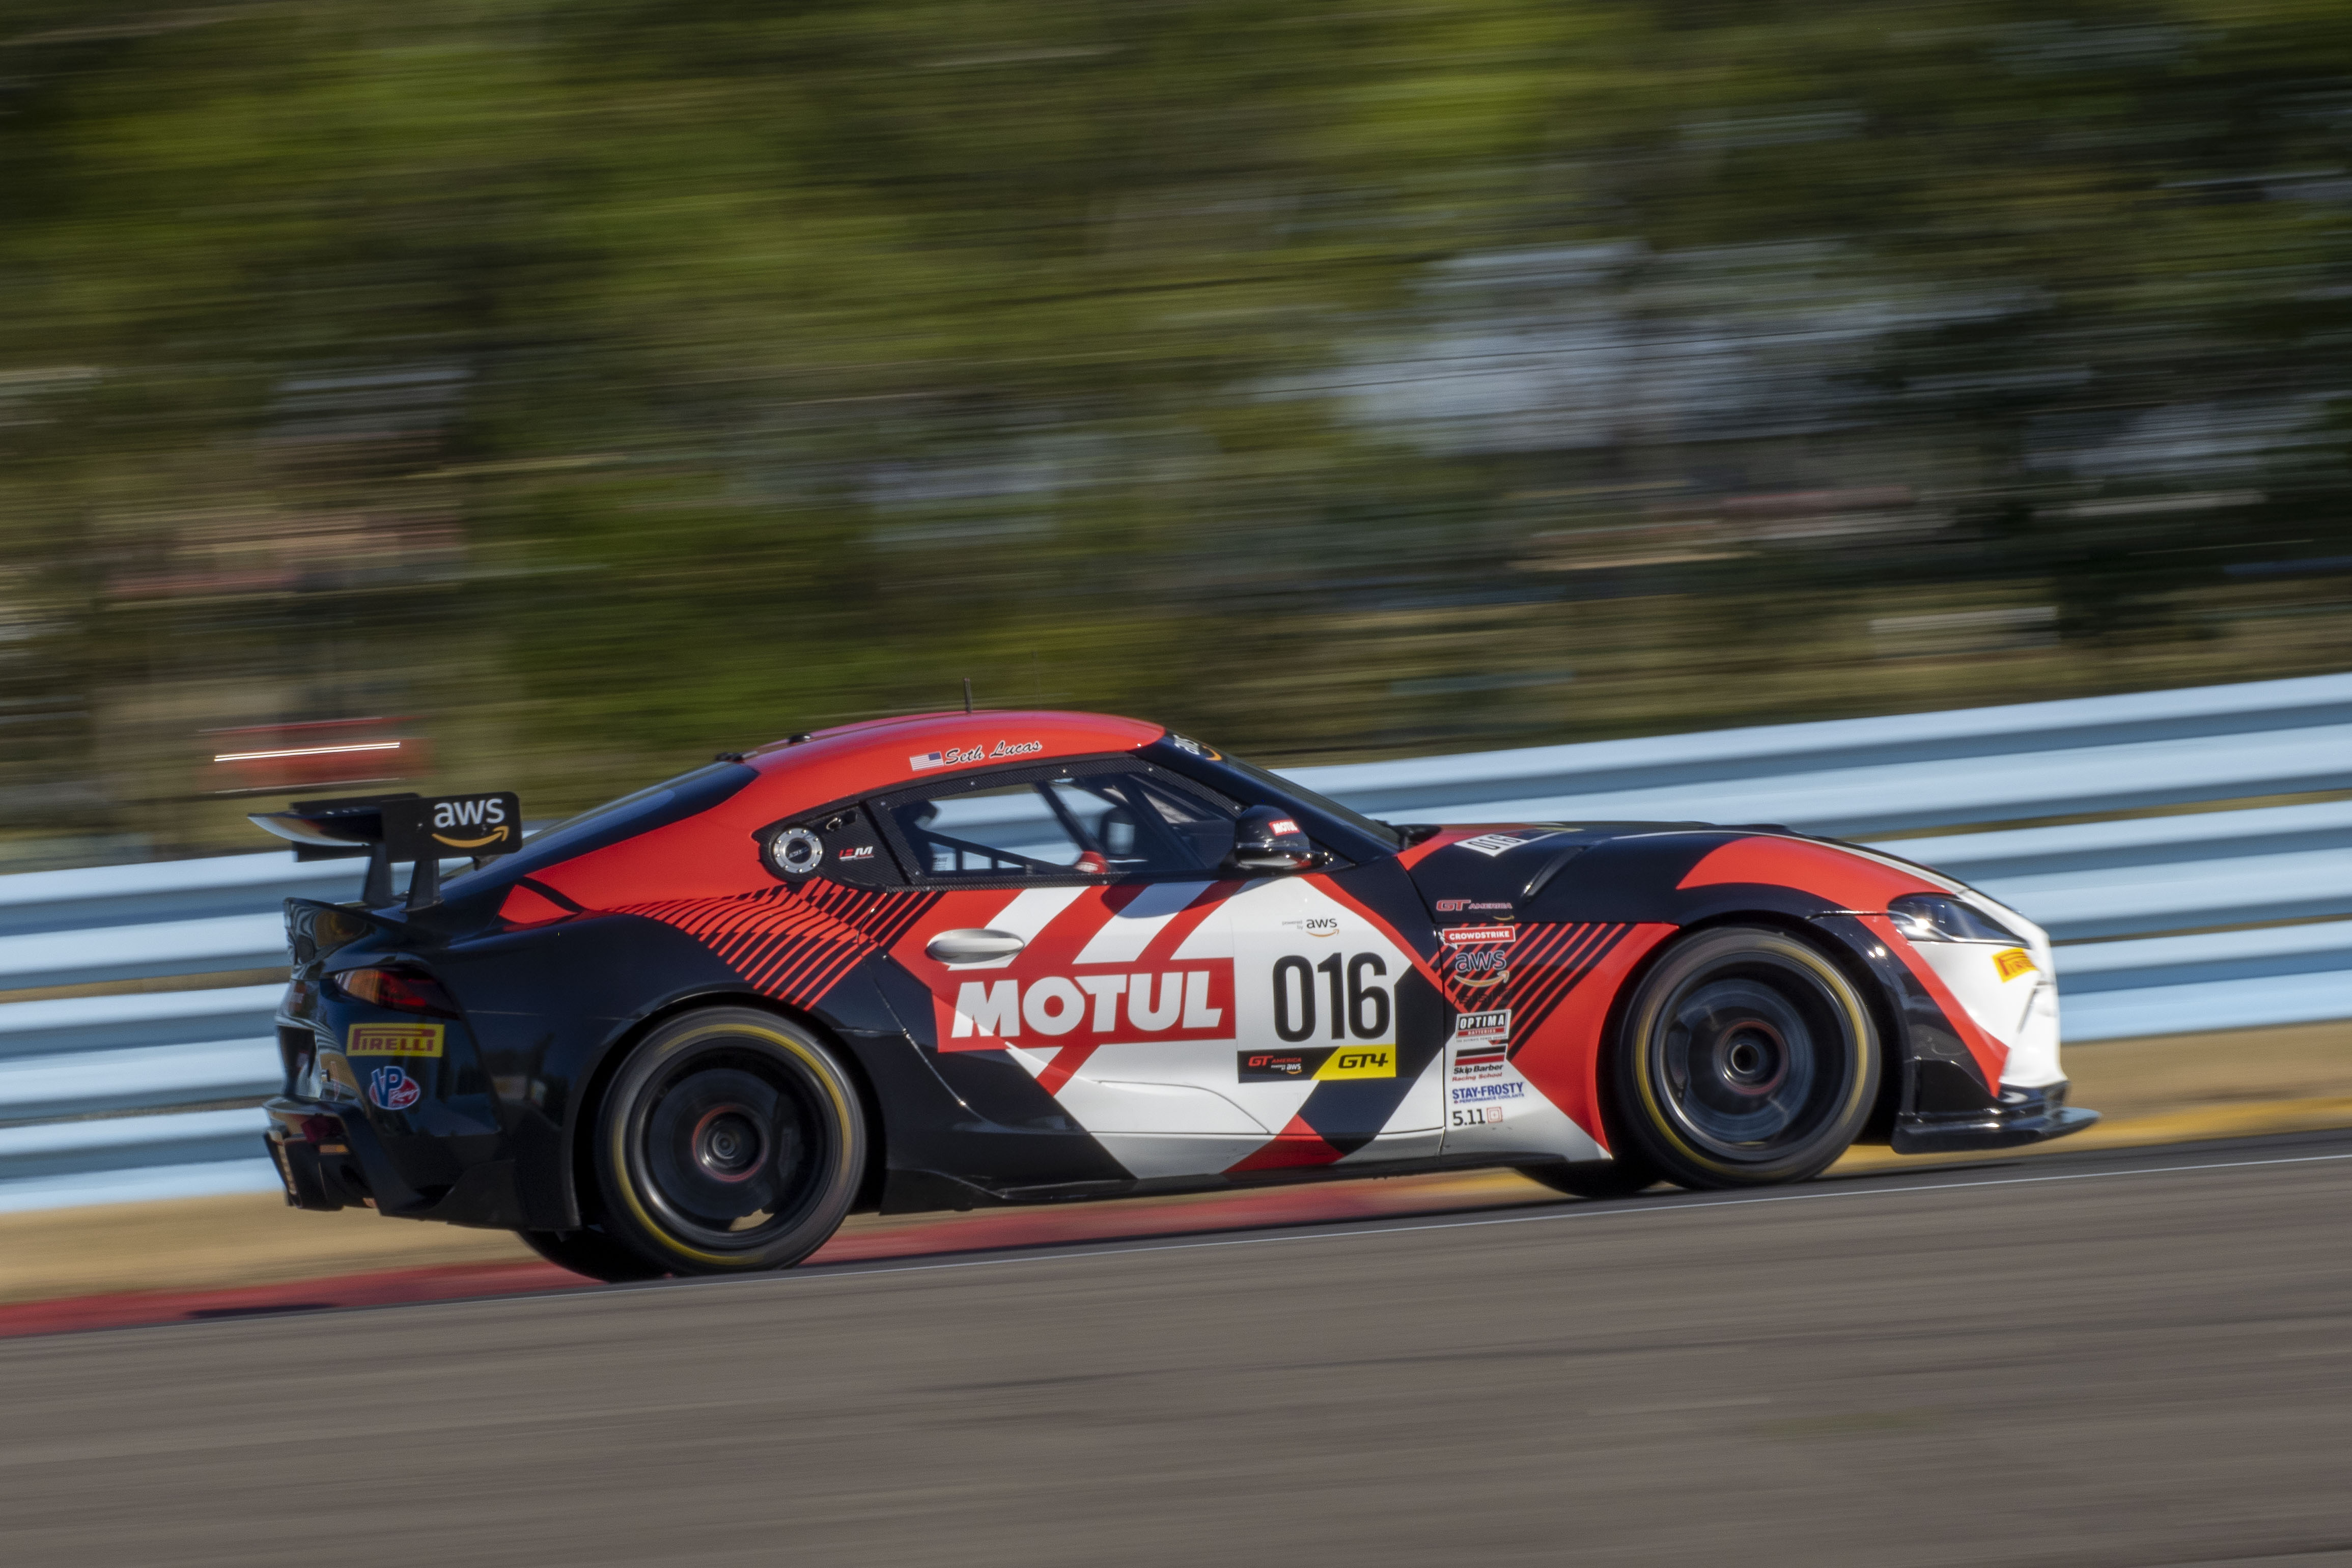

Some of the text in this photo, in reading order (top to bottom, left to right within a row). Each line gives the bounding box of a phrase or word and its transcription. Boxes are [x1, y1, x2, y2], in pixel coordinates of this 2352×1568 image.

[945, 741, 1042, 764] Seth Lucas
[433, 798, 506, 828] aws
[1436, 899, 1471, 911] GT
[1306, 918, 1337, 929] aws
[1449, 930, 1510, 940] CROWDSTRIKE
[1455, 949, 1507, 973] aws
[951, 970, 1222, 1039] MOTUL
[1272, 951, 1390, 1042] 016
[1460, 1014, 1504, 1029] OPTIMA
[352, 1027, 436, 1052] PIRELLI
[1248, 1055, 1274, 1067] GT
[1338, 1053, 1388, 1069] GT4
[1474, 1064, 1503, 1073] Barber
[371, 1066, 406, 1108] VP
[1452, 1082, 1524, 1100] STAY-FROSTY
[1452, 1108, 1486, 1127] 5.11
